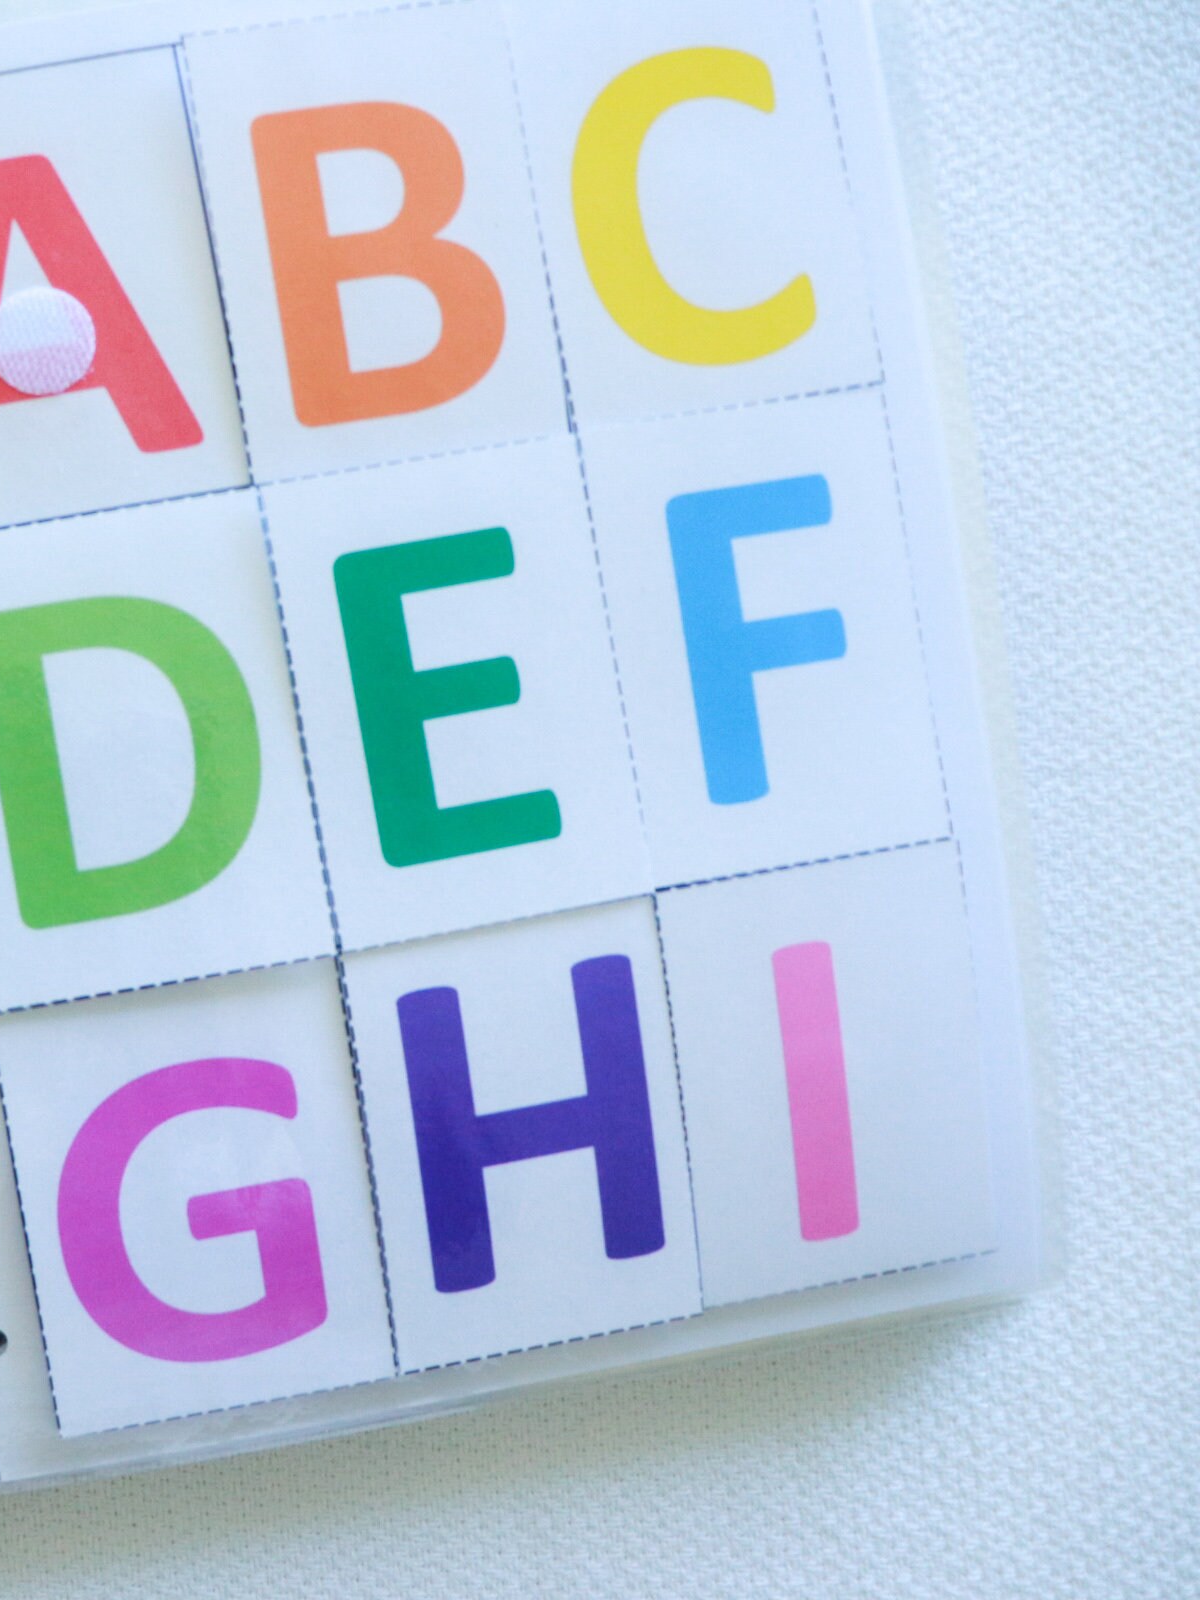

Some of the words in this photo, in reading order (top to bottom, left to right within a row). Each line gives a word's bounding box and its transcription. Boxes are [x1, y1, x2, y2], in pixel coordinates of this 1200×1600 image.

[251, 101, 506, 427] B
[571, 46, 816, 365] C
[332, 526, 563, 869] E
[665, 473, 848, 806] F
[58, 1057, 328, 1363] G
[396, 954, 666, 1293] H
[772, 940, 860, 1242] I
